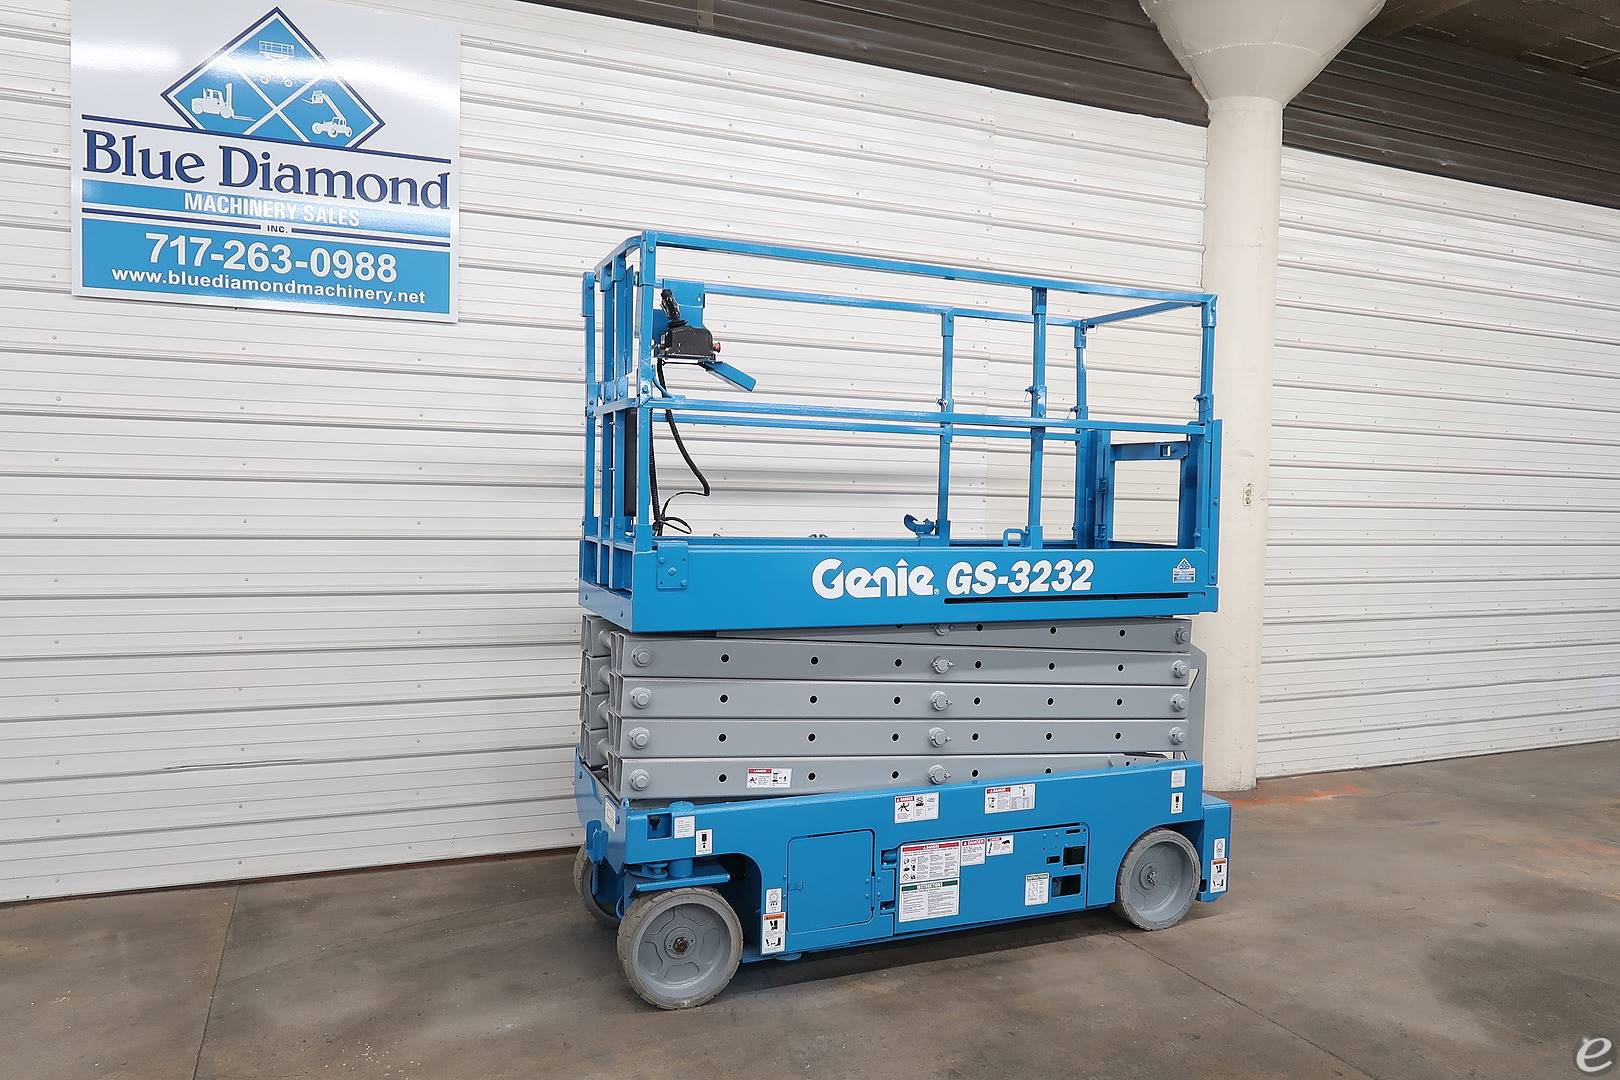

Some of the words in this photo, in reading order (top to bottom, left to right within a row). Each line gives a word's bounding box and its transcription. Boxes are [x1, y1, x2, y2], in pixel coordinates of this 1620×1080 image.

[83, 129, 205, 184] Blue
[219, 145, 450, 210] Diamond
[184, 192, 297, 221] MACHINERY
[303, 203, 361, 227] SALES
[267, 224, 289, 234] INC.
[145, 232, 398, 283] 717-263-0988
[112, 268, 426, 305] www.bluediamondmachinery.net
[812, 558, 936, 599] Genie
[946, 558, 1095, 595] GS-3232
